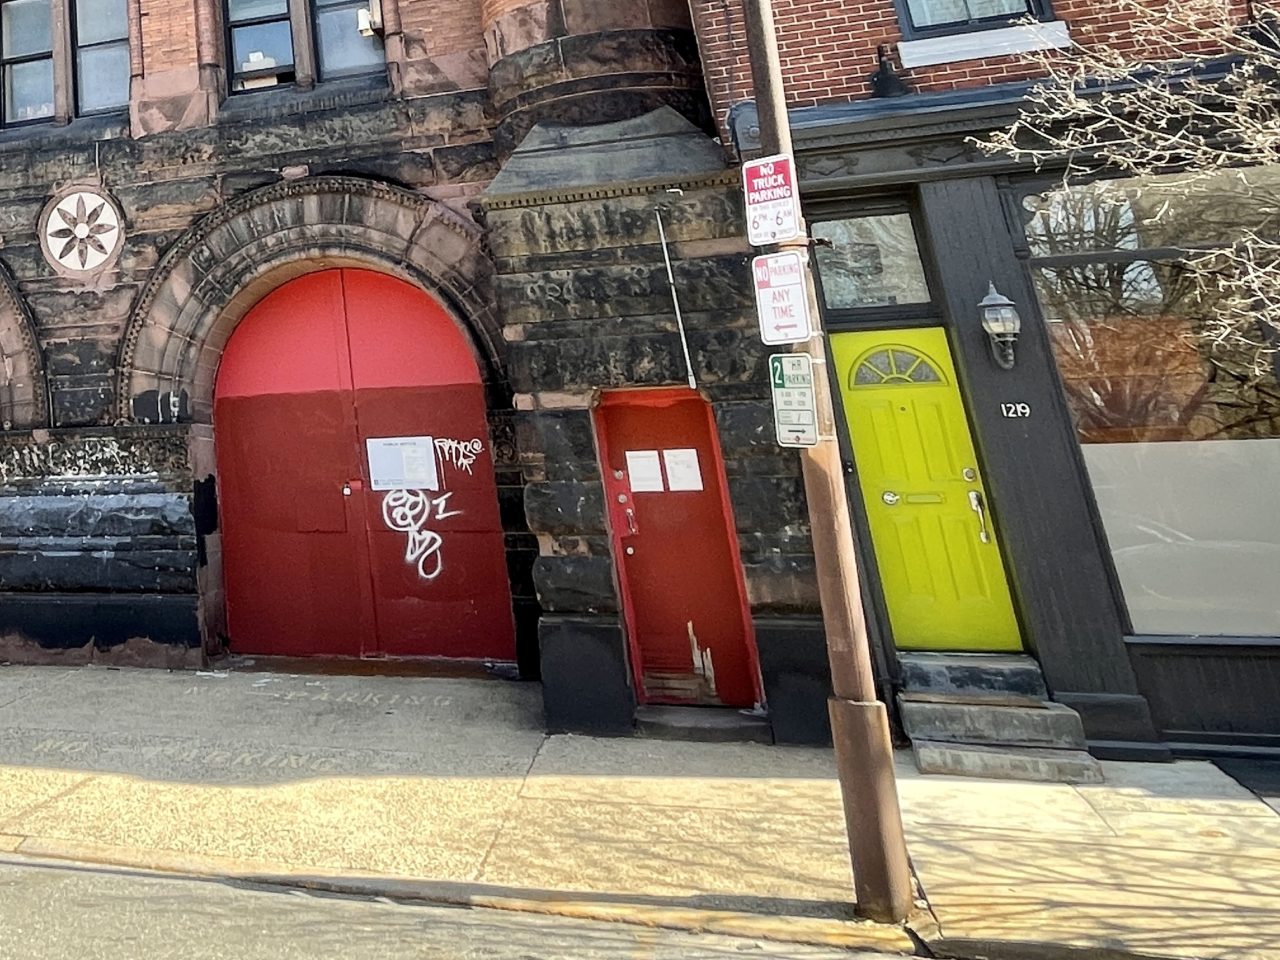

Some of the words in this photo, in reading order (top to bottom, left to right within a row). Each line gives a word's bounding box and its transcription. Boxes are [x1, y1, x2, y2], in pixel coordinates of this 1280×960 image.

[760, 163, 774, 176] NO
[752, 174, 785, 190] TRUCK
[749, 186, 791, 203] PARKING
[756, 266, 769, 282] NO
[770, 263, 798, 275] PARKING
[772, 288, 790, 304] ANY
[772, 304, 795, 319] TIME
[773, 361, 783, 384] 2
[784, 373, 811, 385] PARKING
[791, 359, 803, 371] HR
[1000, 402, 1031, 418] 1219
